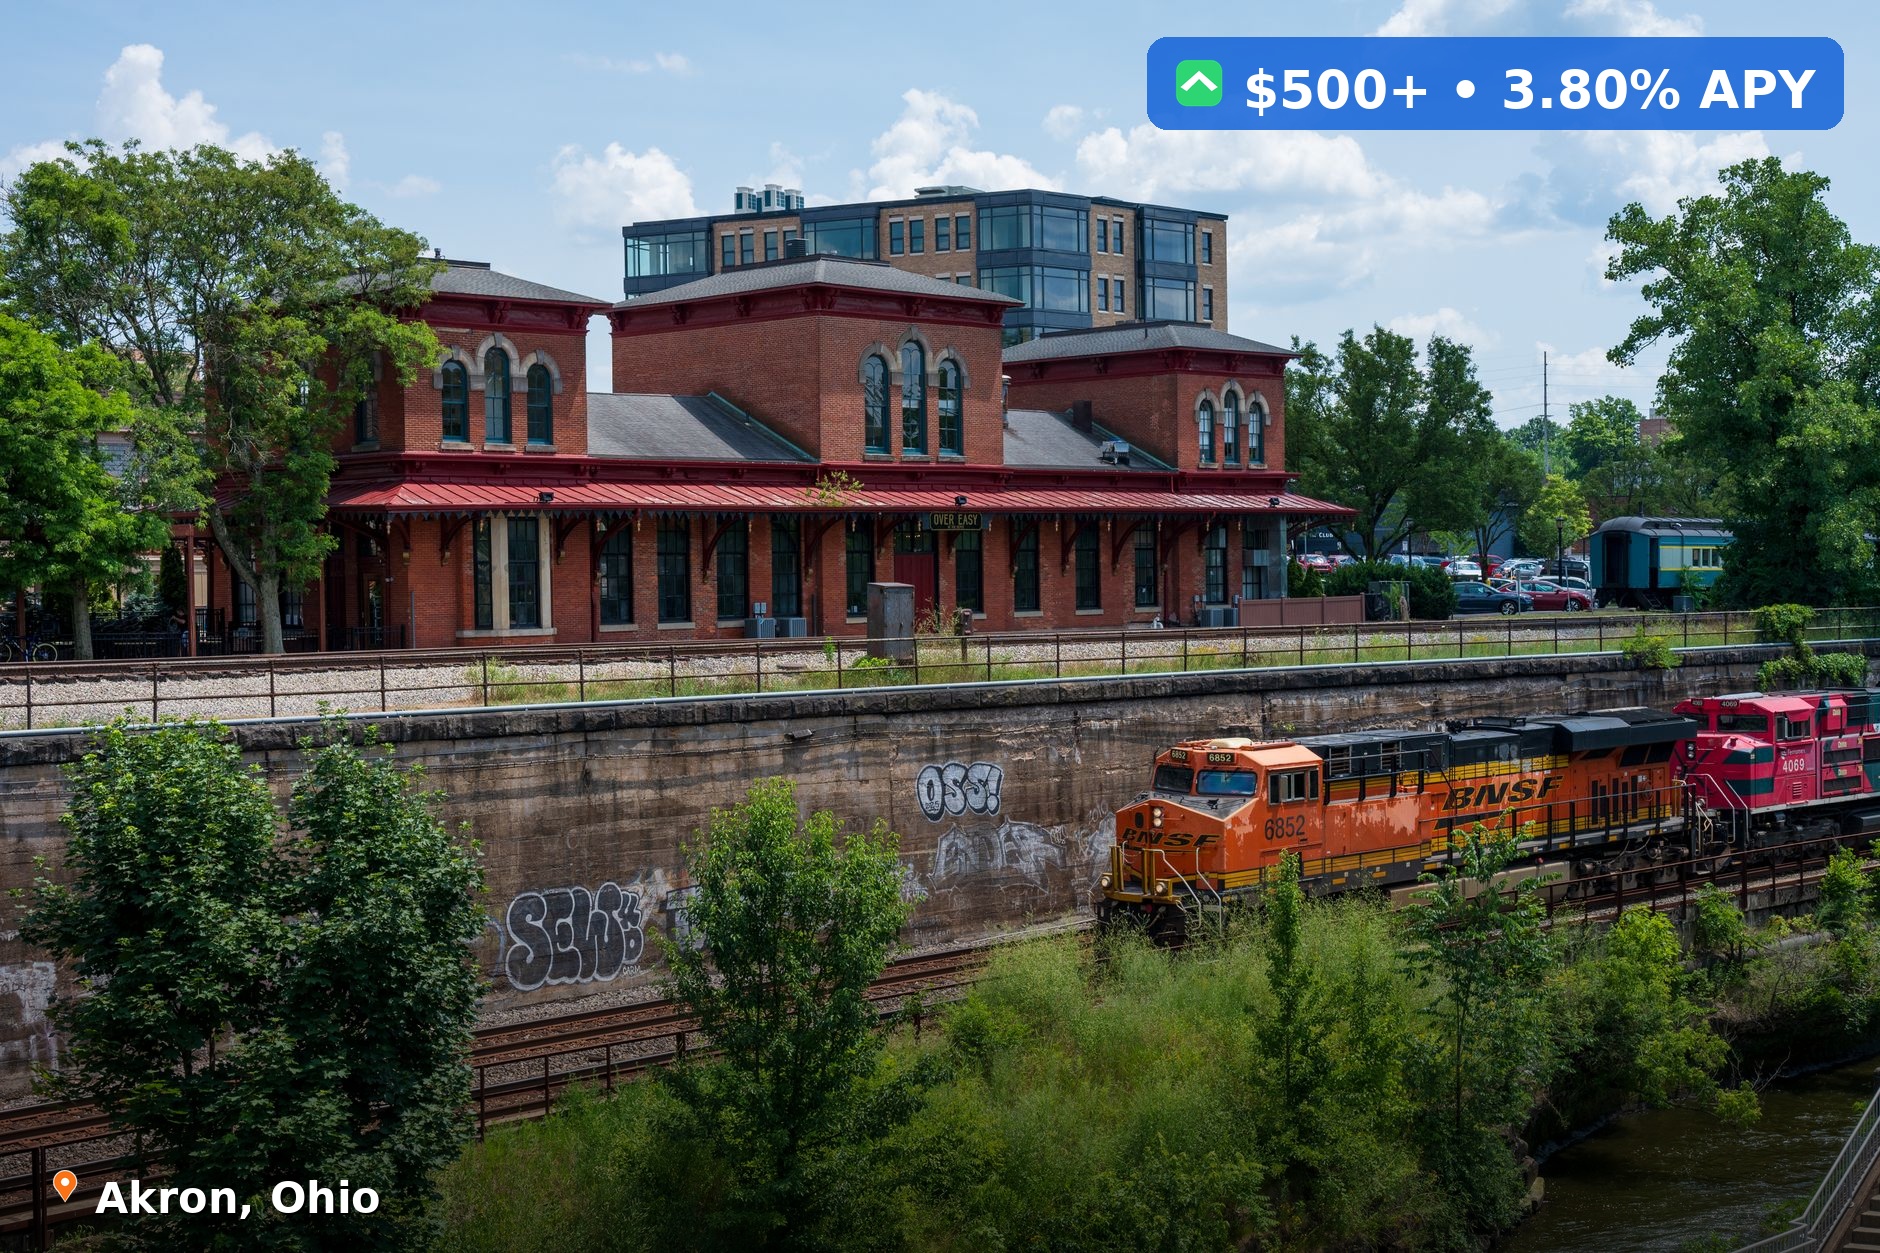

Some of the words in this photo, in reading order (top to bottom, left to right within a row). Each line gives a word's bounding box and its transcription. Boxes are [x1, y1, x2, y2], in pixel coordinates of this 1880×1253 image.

[933, 513, 955, 526] OVER
[959, 513, 978, 526] EASY
[1171, 750, 1186, 759] 6852
[1209, 753, 1231, 762] 6852
[1782, 758, 1805, 772] 4069
[1441, 775, 1563, 812] BNSF
[1264, 814, 1306, 841] 6852
[1121, 827, 1221, 848] BNSF
